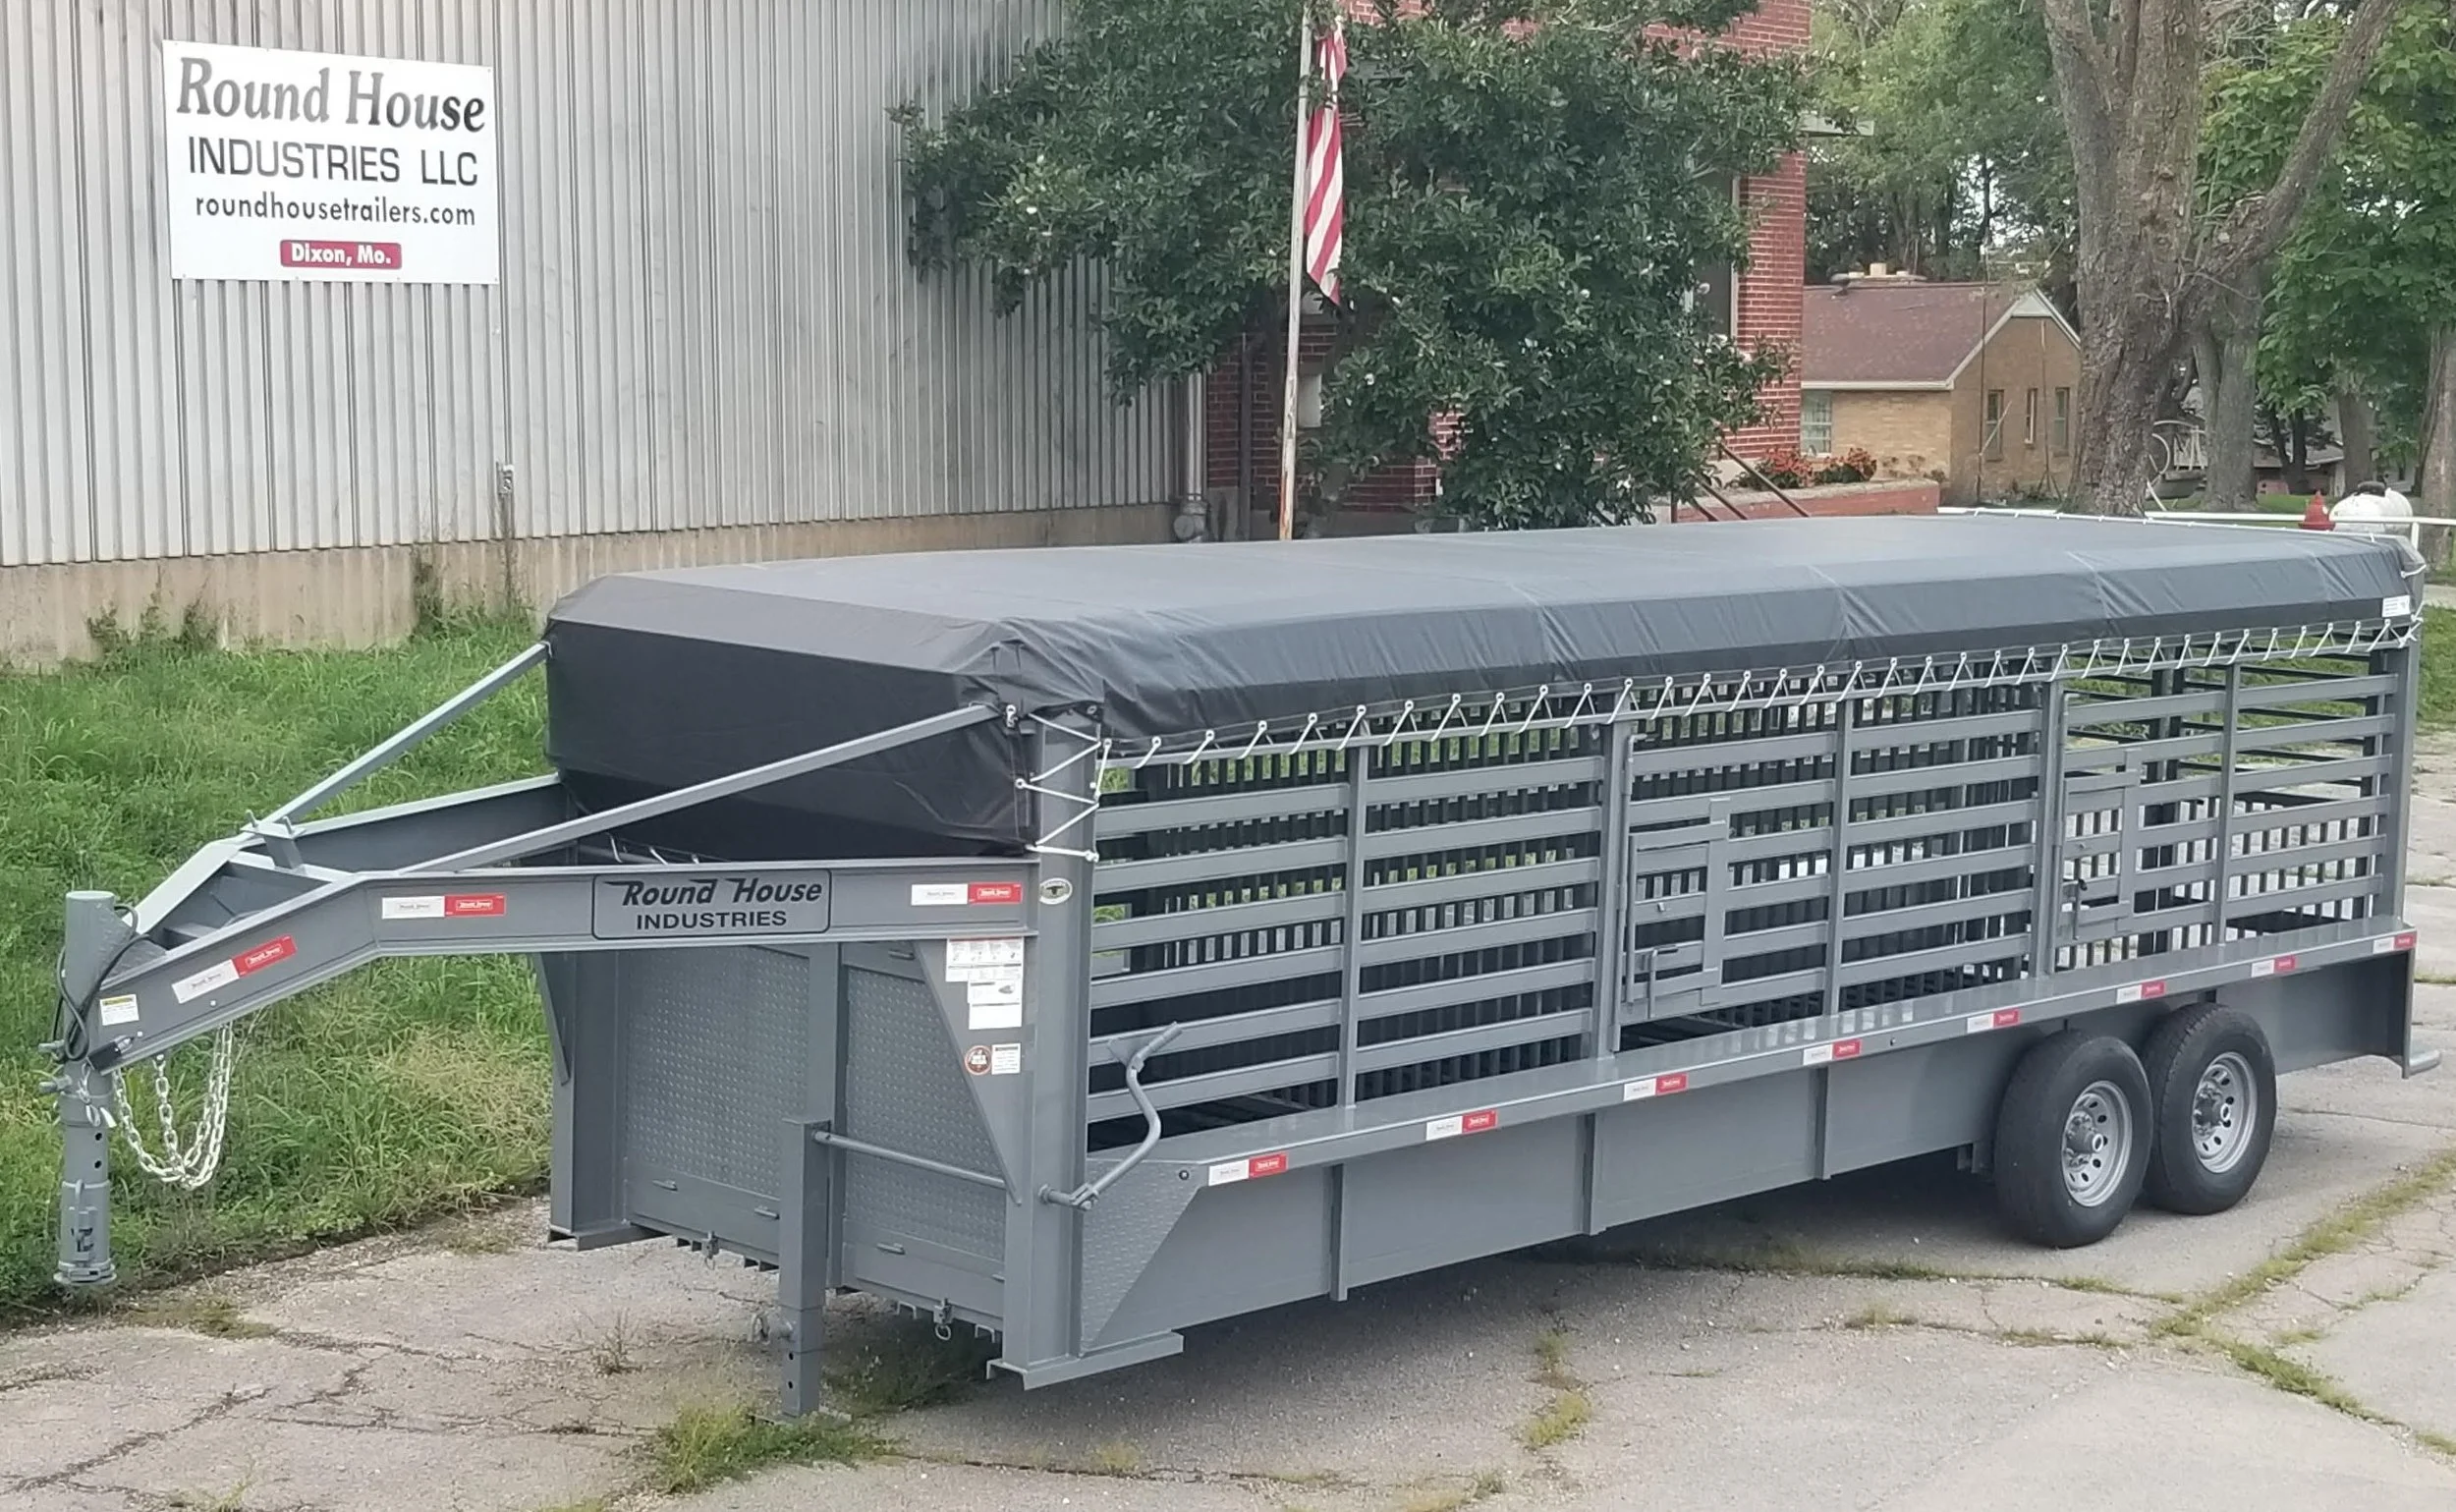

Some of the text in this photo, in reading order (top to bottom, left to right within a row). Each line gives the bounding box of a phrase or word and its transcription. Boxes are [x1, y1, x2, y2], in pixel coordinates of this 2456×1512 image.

[176, 57, 485, 132] Round House
[189, 136, 477, 186] INDUSTRIES LLC
[195, 192, 475, 226] roundhousetrailers.com
[291, 243, 391, 266] Dixon, Mo.
[602, 877, 822, 906] Round House
[637, 911, 787, 930] INDUSTRIES
